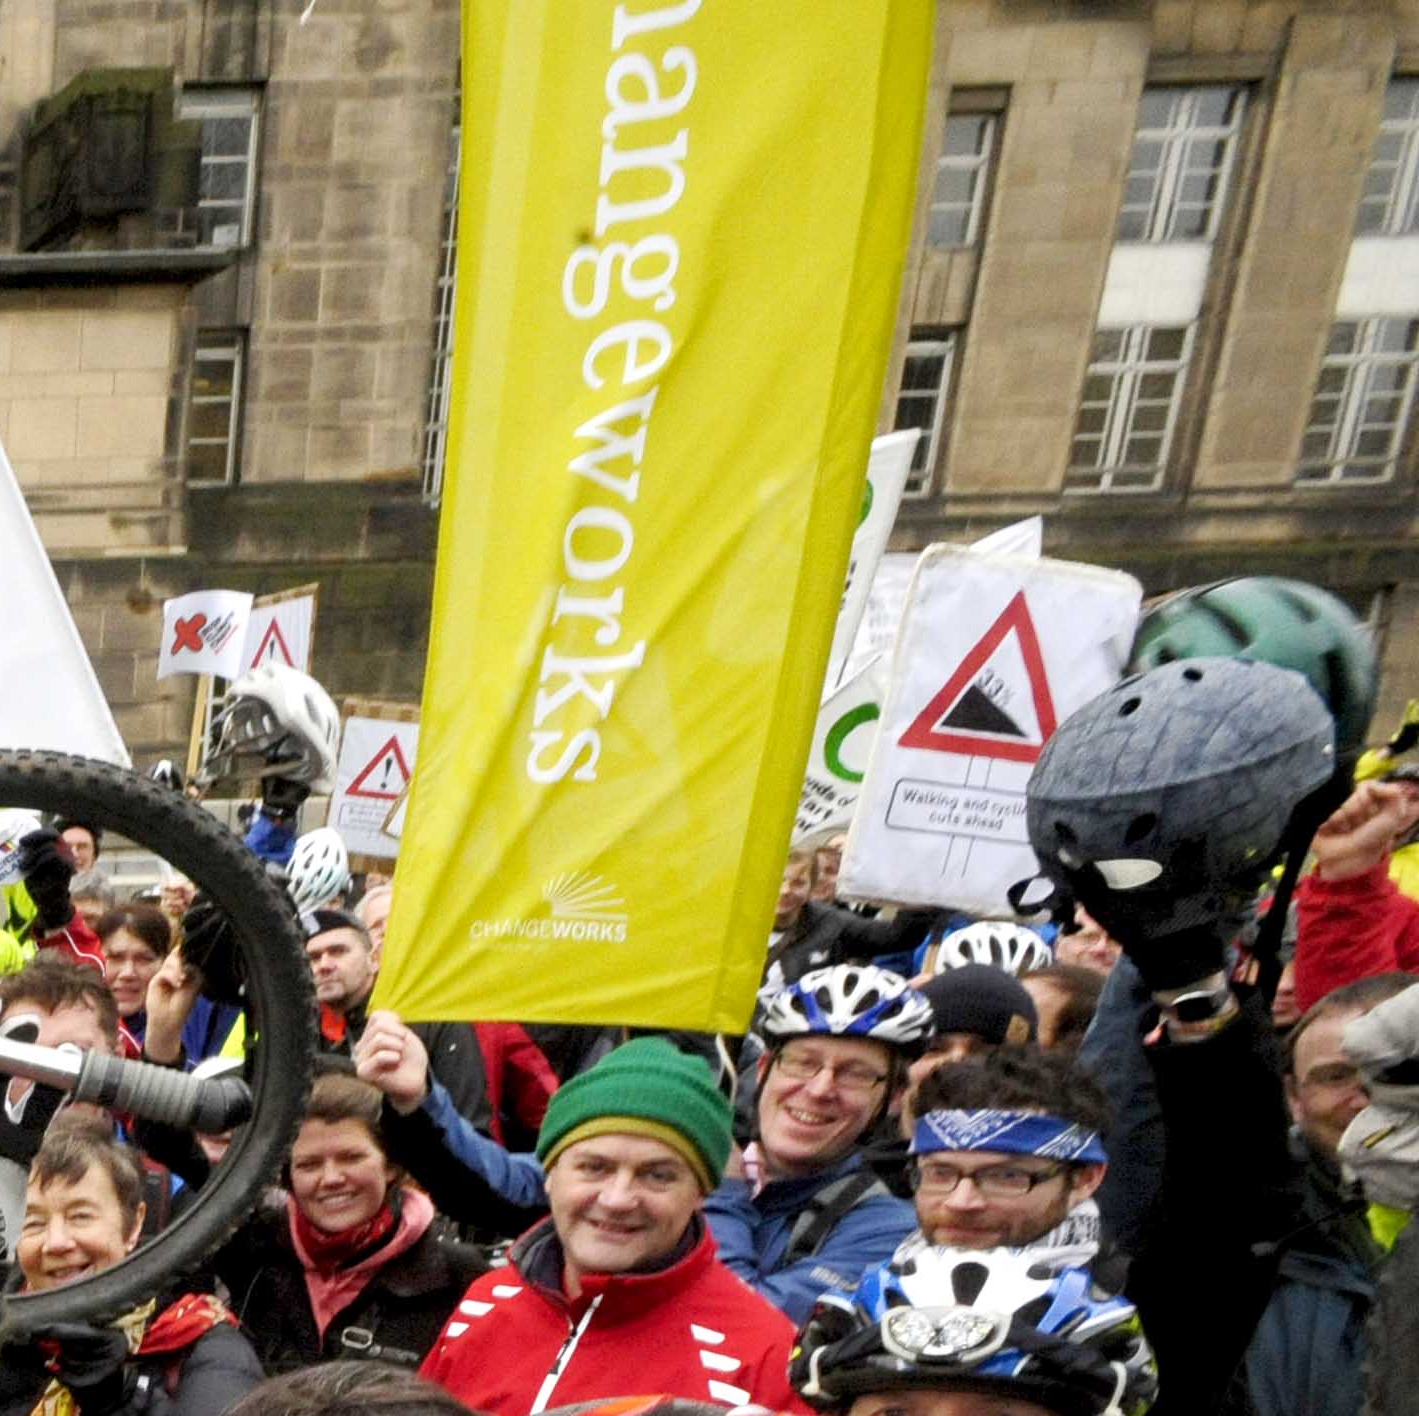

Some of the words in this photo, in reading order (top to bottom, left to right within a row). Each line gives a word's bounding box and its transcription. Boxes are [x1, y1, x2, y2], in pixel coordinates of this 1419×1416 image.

[903, 788, 958, 813] Walking
[962, 795, 988, 810] and
[962, 814, 1004, 832] ahead
[469, 918, 629, 943] CHANGEWORKS
